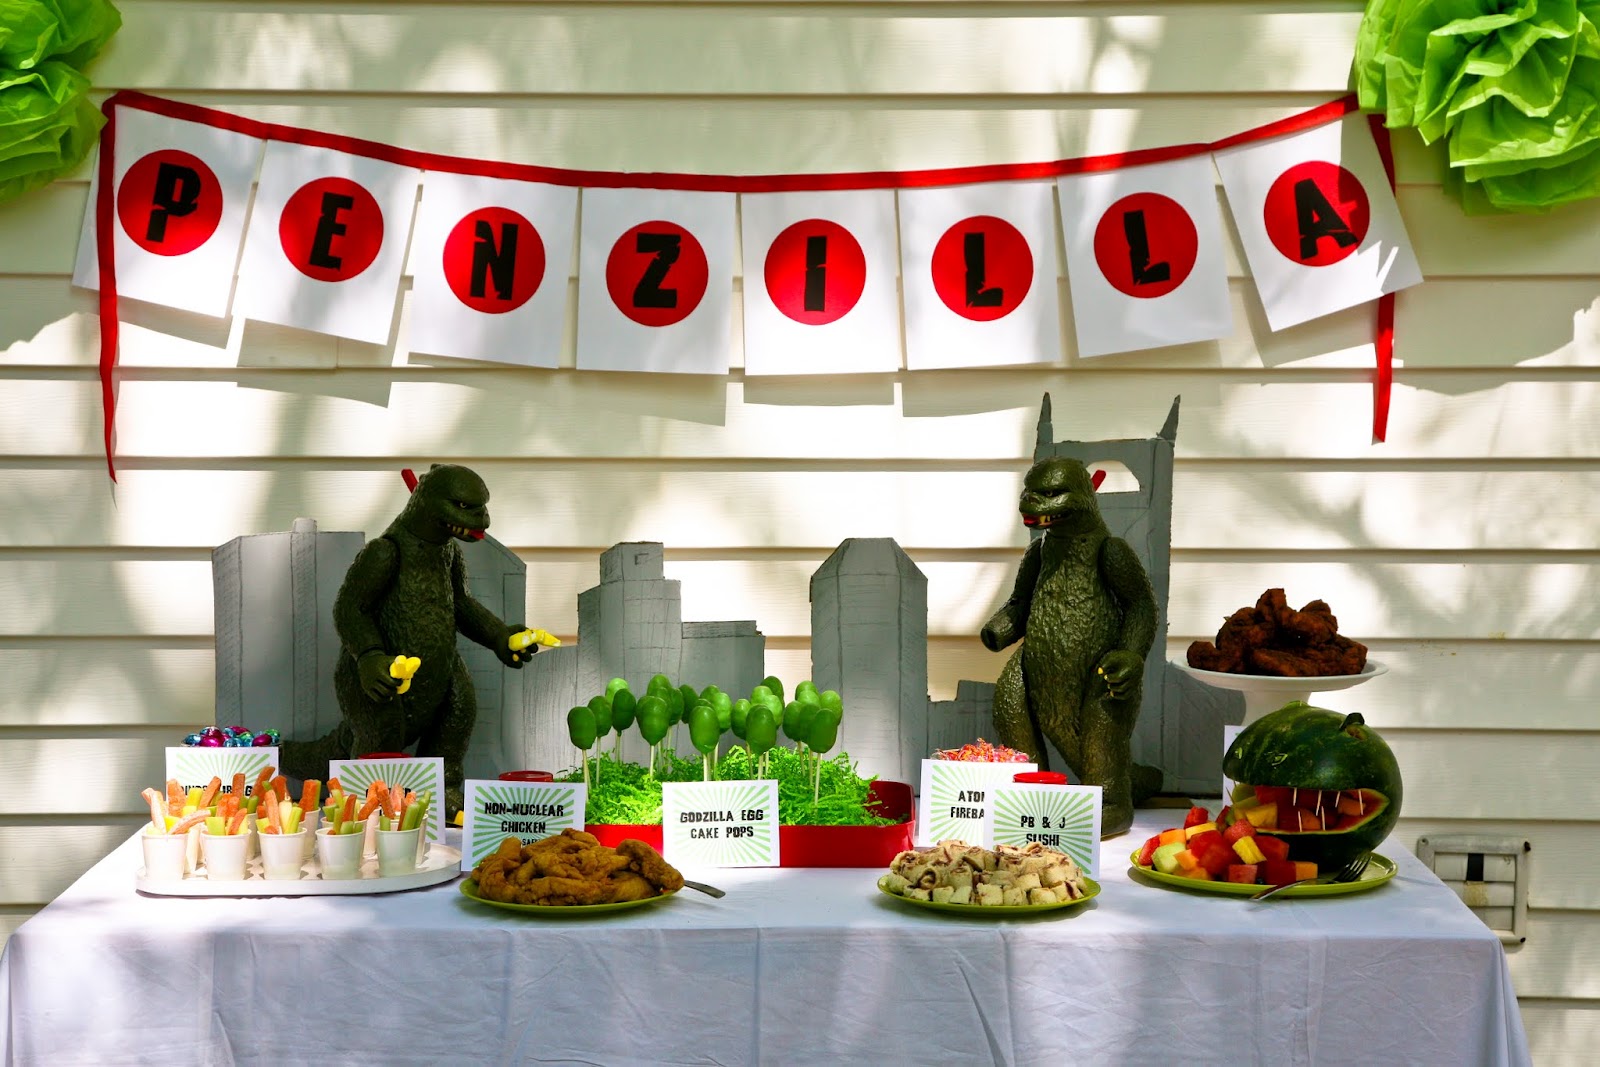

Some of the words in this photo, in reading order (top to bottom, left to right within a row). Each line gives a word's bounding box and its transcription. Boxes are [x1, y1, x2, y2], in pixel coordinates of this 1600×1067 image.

[146, 161, 1358, 312] PENZILLA
[484, 802, 564, 817] NON-NUCLEAR
[680, 810, 734, 823] GODZILLA
[741, 809, 764, 821] EGG
[501, 820, 546, 834] CHICKEN
[1020, 815, 1035, 828] PB
[1042, 816, 1051, 829] &
[1059, 817, 1066, 829] J
[690, 827, 719, 839] CAKE
[726, 825, 754, 838] POPS
[1025, 833, 1060, 846] SUSHI
